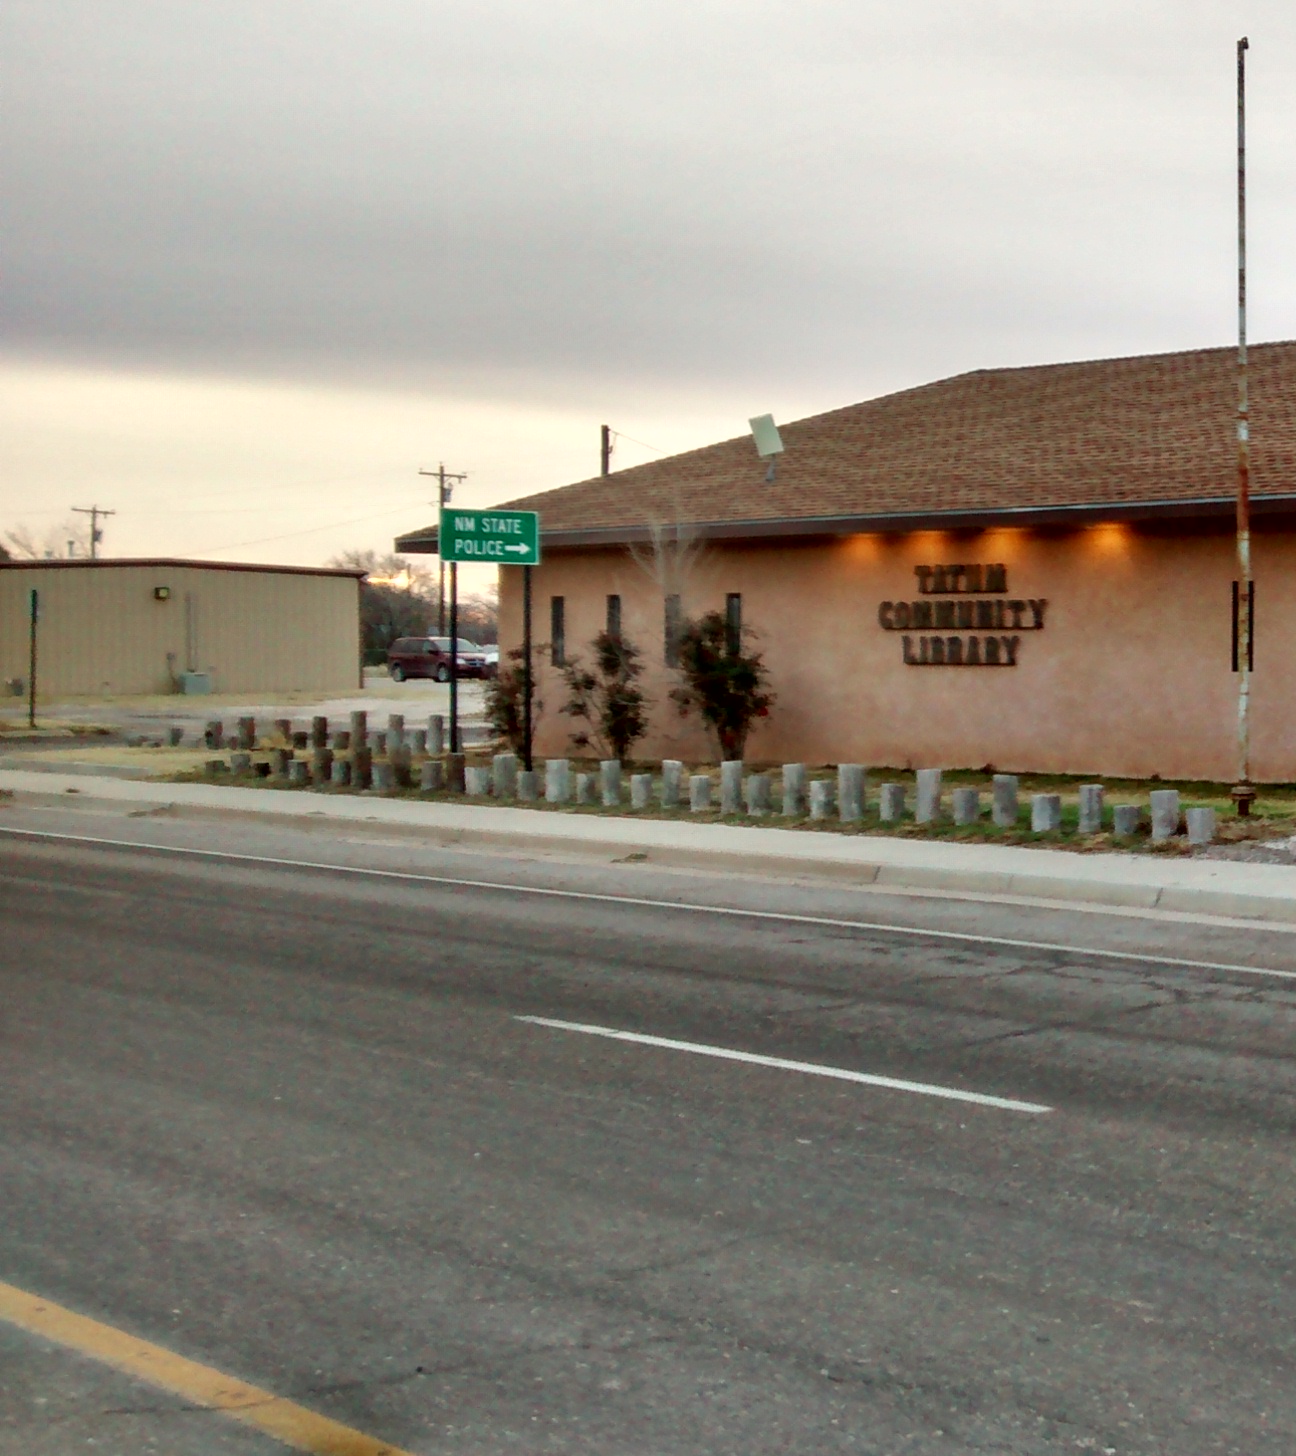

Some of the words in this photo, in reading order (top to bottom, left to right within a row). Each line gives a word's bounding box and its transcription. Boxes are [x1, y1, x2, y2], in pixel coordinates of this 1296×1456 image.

[454, 516, 475, 531] NM
[481, 518, 522, 534] STATE
[454, 538, 504, 555] POLICE
[878, 599, 1048, 630] COMMUNITY
[901, 635, 1020, 666] LIBRARY
